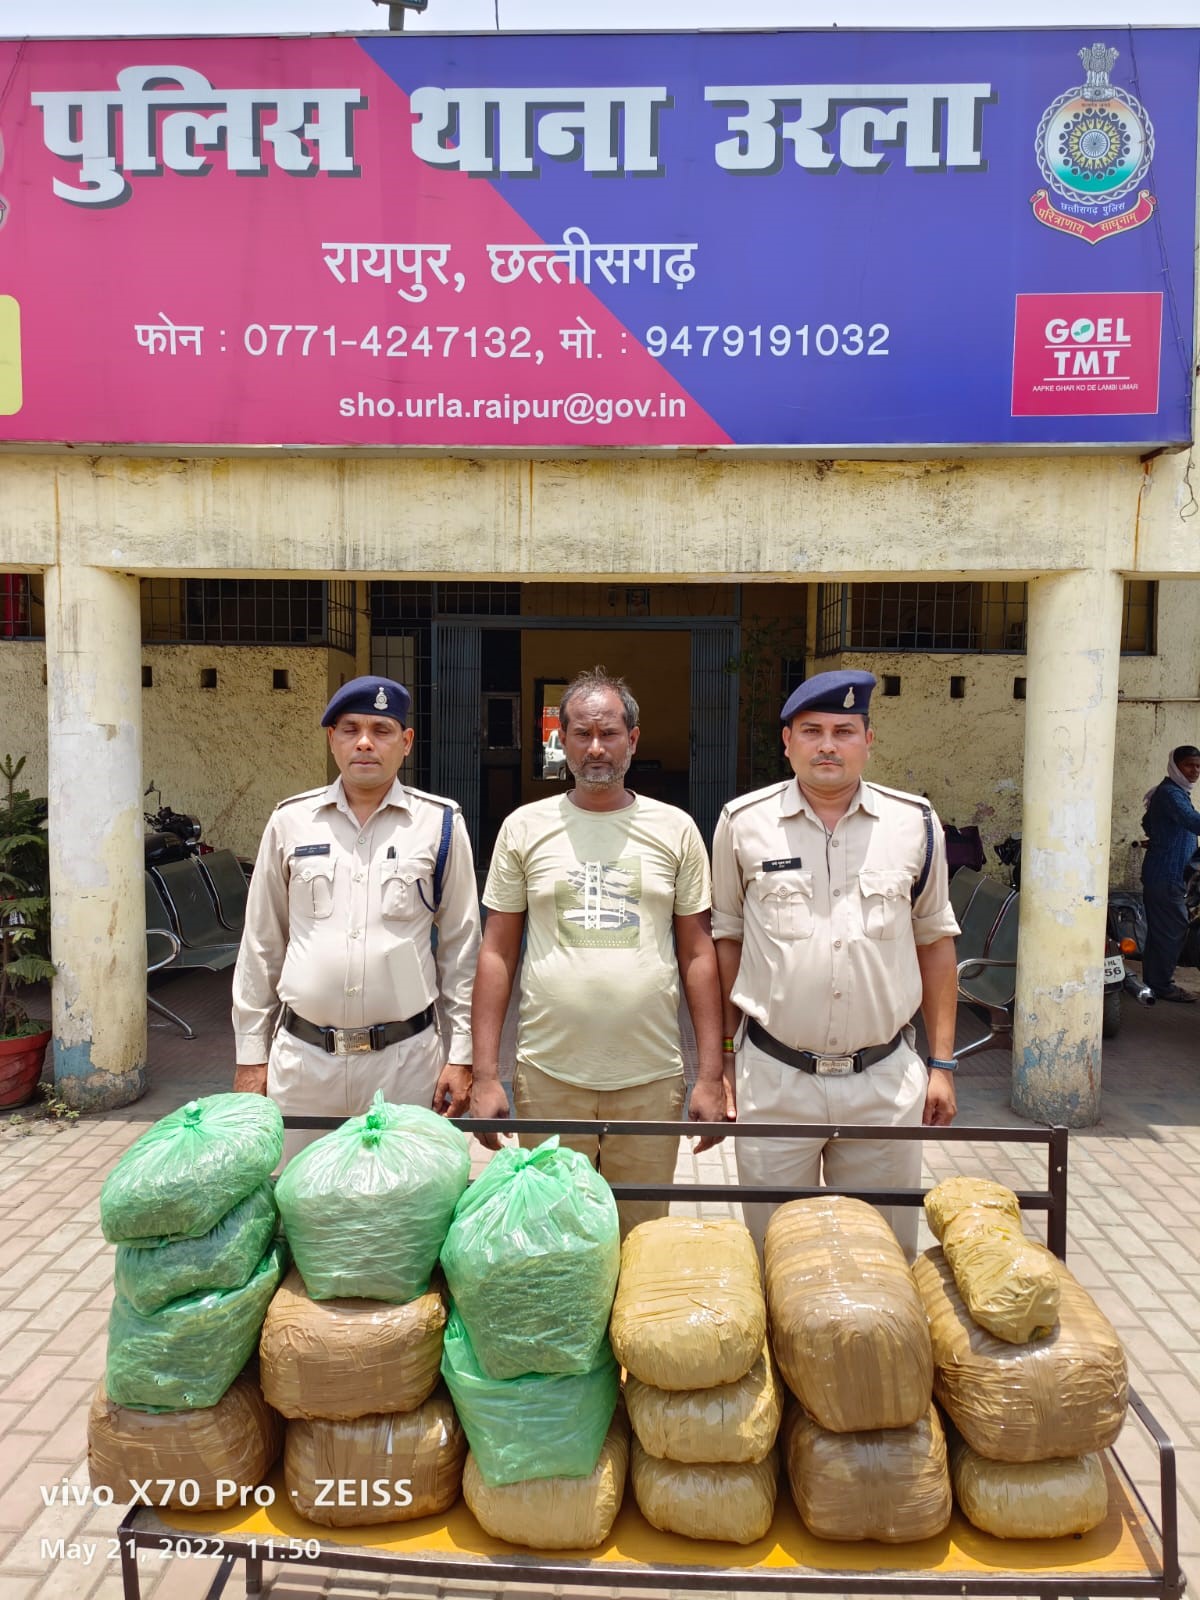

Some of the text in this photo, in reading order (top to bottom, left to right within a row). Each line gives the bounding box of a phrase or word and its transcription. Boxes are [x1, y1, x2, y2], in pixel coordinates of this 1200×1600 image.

[31, 65, 996, 206] पुलिस थाना उरला
[1102, 202, 1126, 216] पुलिस
[321, 227, 699, 303] रायपुर, छत्तीसगढ़
[135, 312, 204, 356] फोन
[243, 323, 545, 365] 0771-4247132,
[559, 316, 604, 359] मो.
[646, 323, 890, 358] 9479191032
[1044, 317, 1132, 344] GOEL
[1053, 350, 1121, 376] TMT
[339, 391, 687, 425] sho.urla.raipur@gov.in
